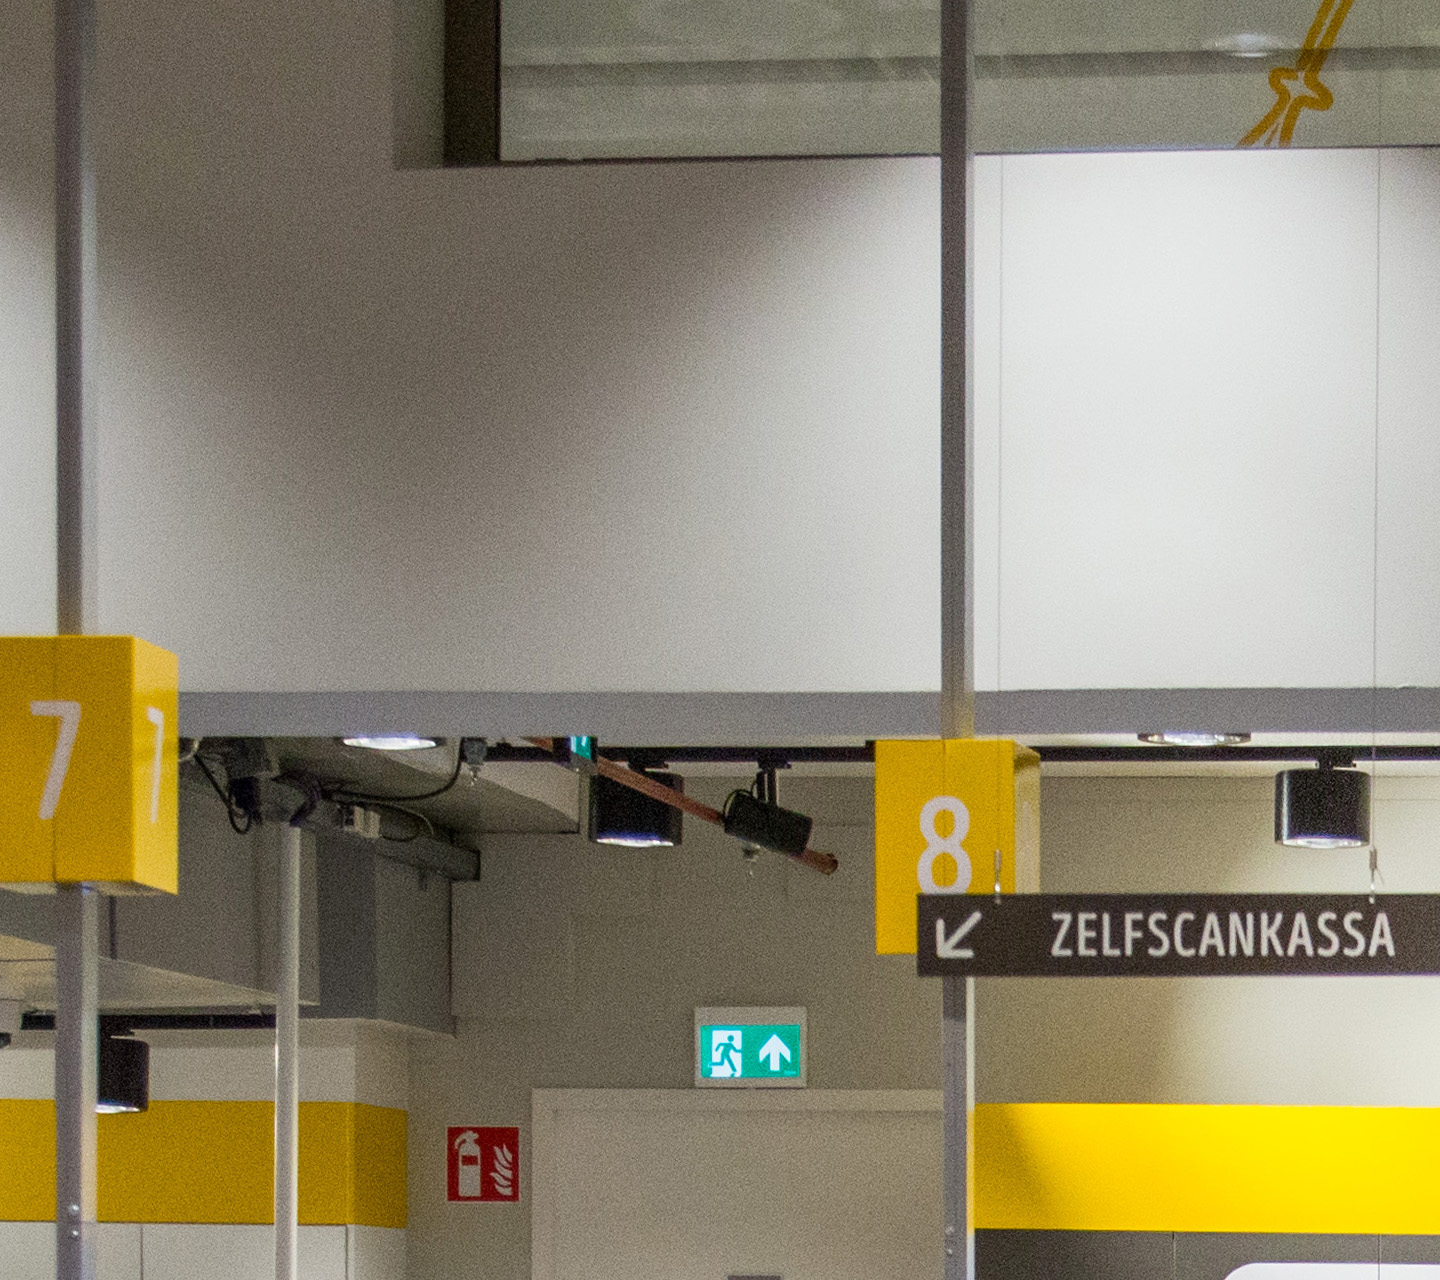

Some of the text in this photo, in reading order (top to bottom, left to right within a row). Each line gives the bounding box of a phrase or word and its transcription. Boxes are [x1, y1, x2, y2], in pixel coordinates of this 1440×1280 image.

[29, 699, 82, 820] 7
[917, 795, 973, 894] 8
[1050, 911, 1396, 958] ZELFSCANKASSA
